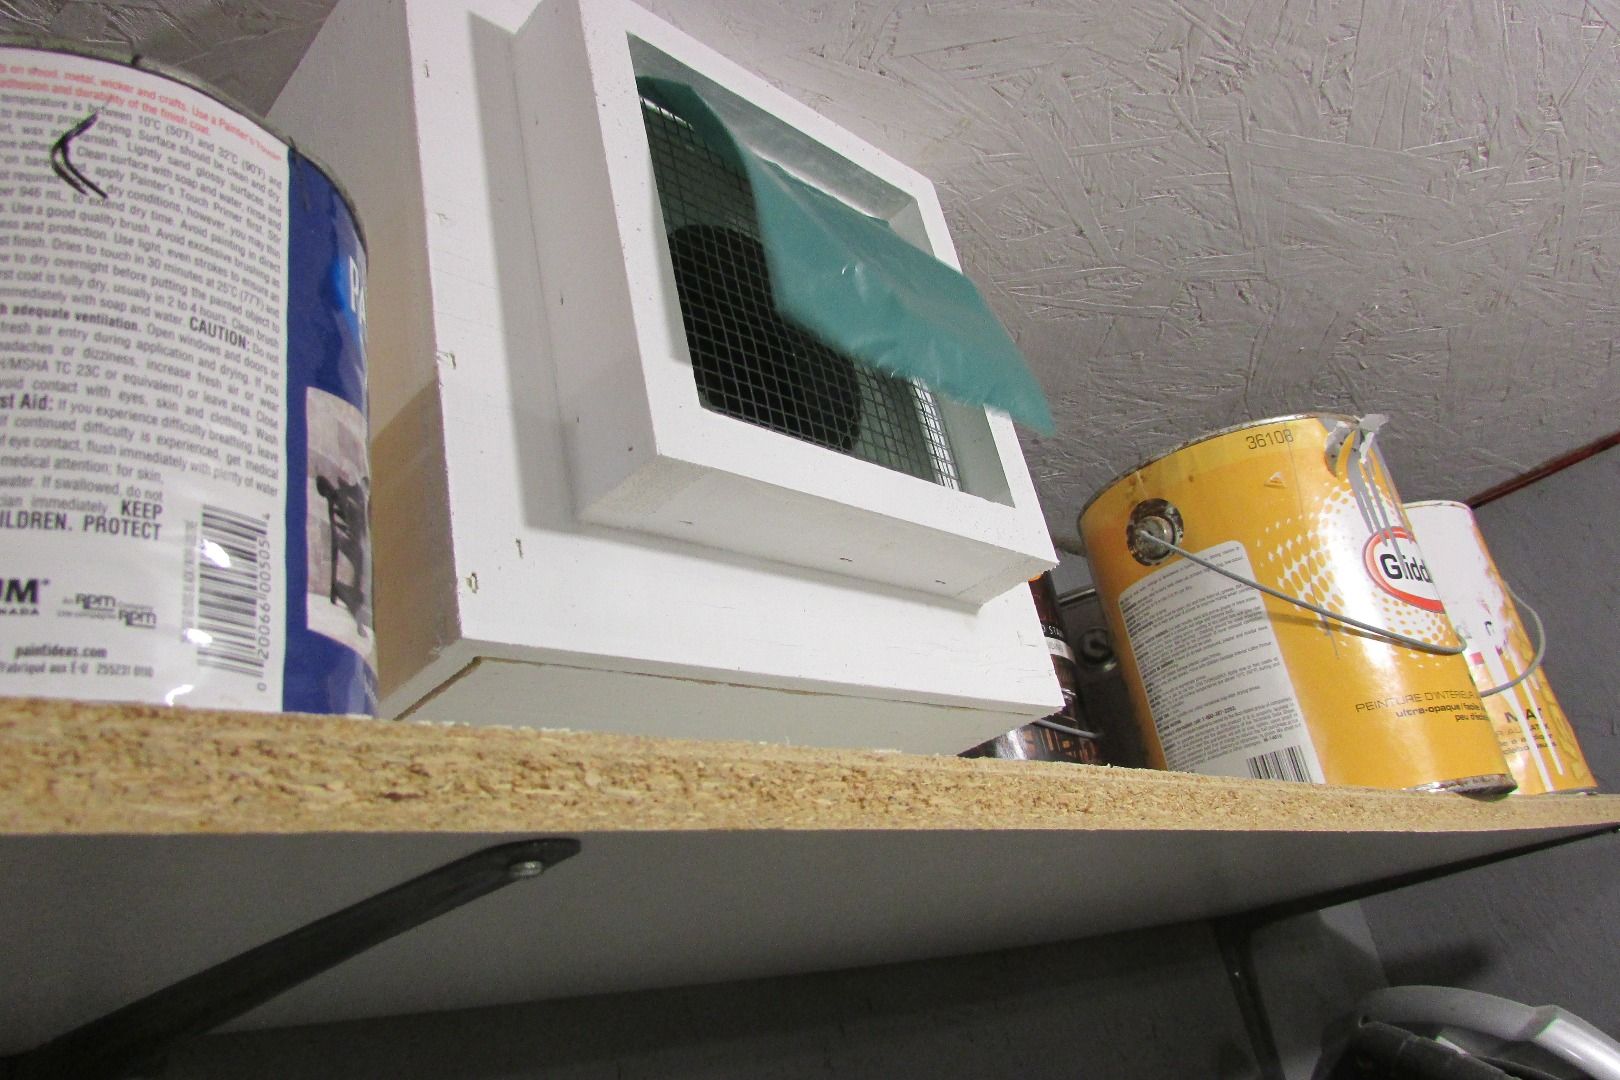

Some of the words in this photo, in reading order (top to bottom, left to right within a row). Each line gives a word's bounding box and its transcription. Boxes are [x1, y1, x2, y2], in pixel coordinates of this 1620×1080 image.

[190, 316, 250, 350] CAUTION:
[1245, 428, 1294, 450] 36108
[120, 499, 164, 520] KEEP
[84, 515, 162, 541] PROTECT
[1379, 553, 1434, 583] Gidd
[1354, 692, 1423, 713] PEINTURE
